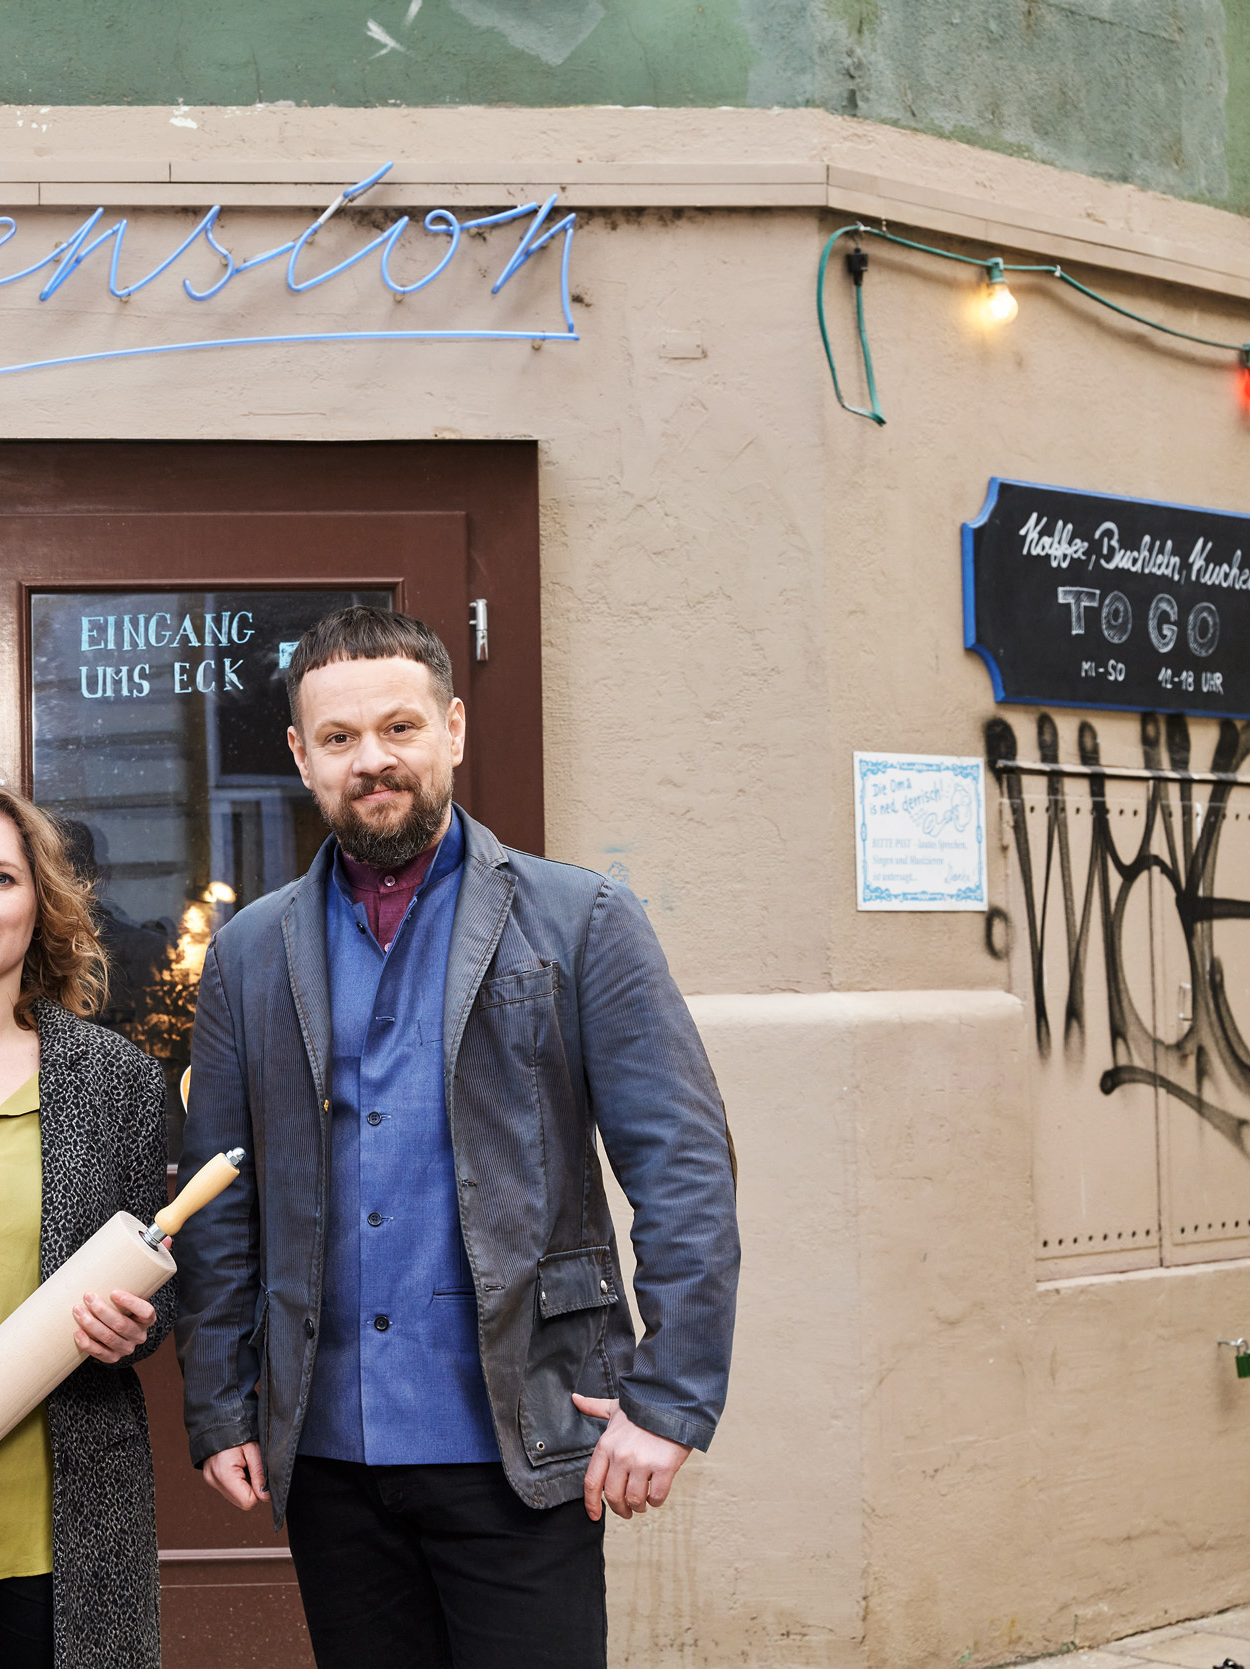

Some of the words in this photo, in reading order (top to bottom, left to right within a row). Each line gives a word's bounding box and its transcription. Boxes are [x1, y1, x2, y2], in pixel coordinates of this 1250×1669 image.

[1188, 536, 1250, 590] Kuche
[80, 611, 256, 651] EINGANG
[1057, 586, 1133, 644] TO
[1148, 593, 1221, 658] GO
[79, 663, 151, 699] UMS
[173, 657, 244, 694] ECK
[1201, 671, 1225, 696] UHR
